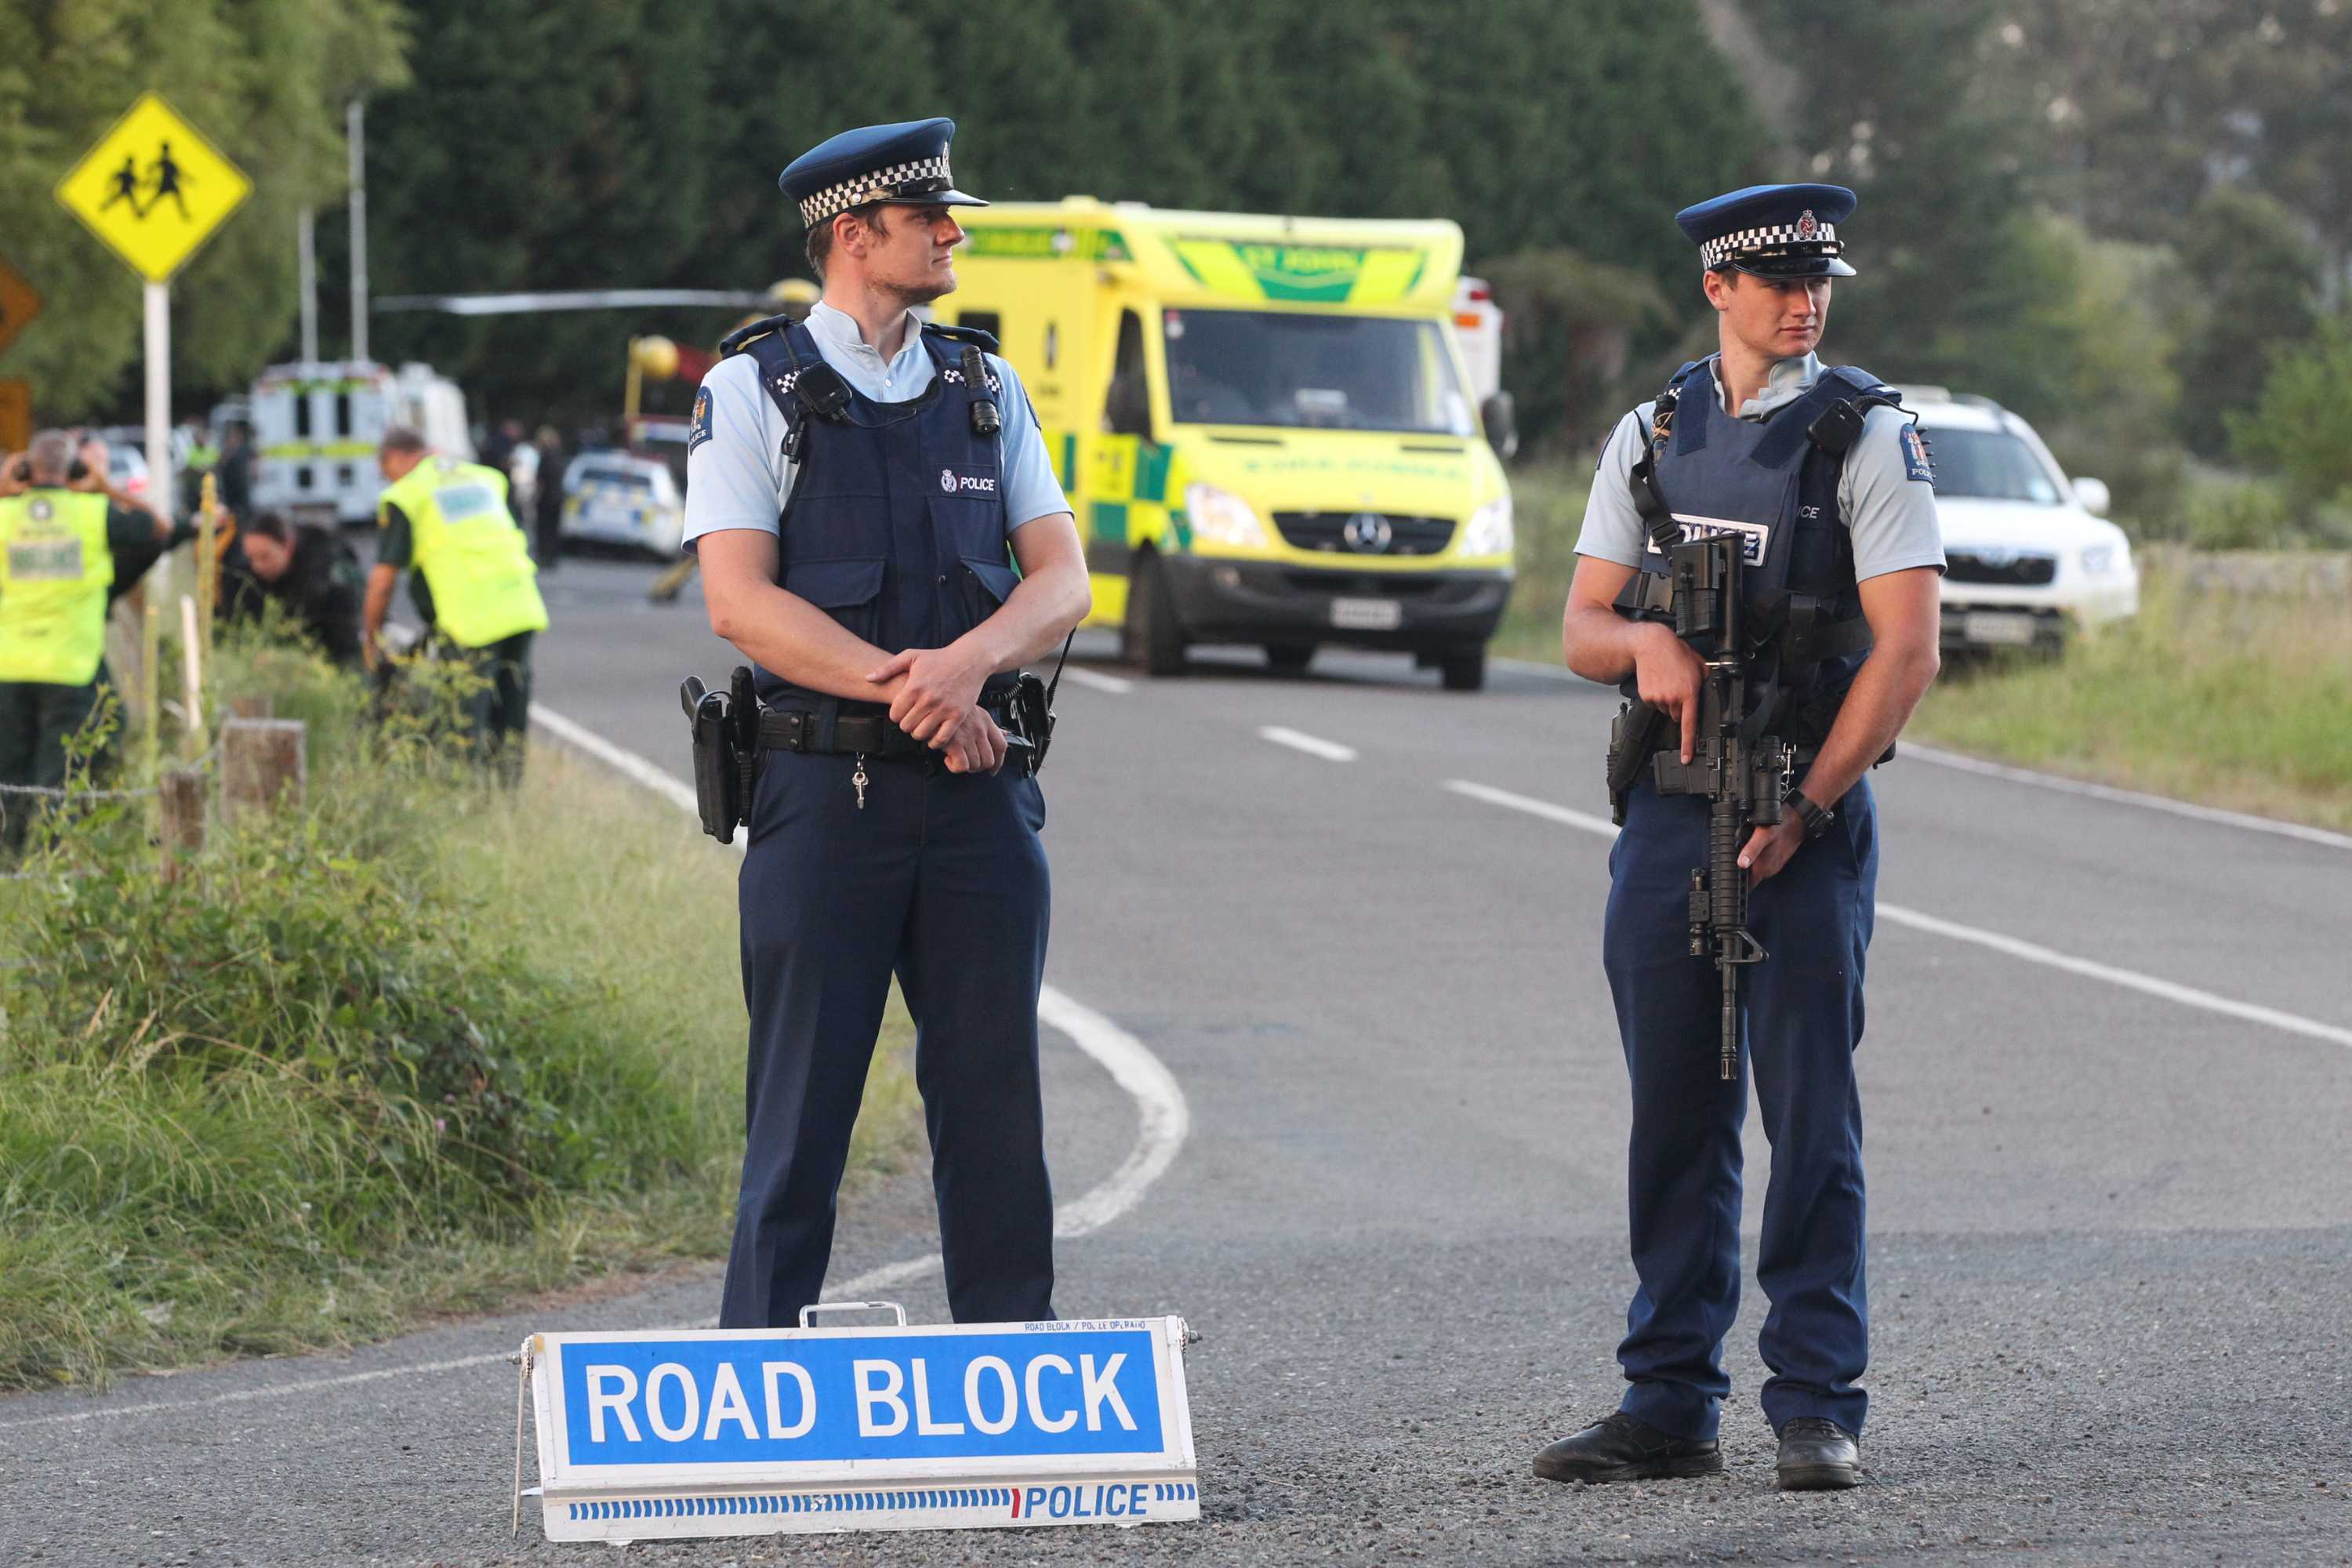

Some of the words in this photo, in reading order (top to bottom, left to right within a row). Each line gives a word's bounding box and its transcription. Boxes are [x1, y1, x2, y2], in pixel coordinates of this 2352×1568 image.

[960, 477, 995, 492] POLICE
[586, 1362, 816, 1443] ROAD
[852, 1352, 1138, 1438] BLOCK
[1025, 1484, 1149, 1518] POLICE
